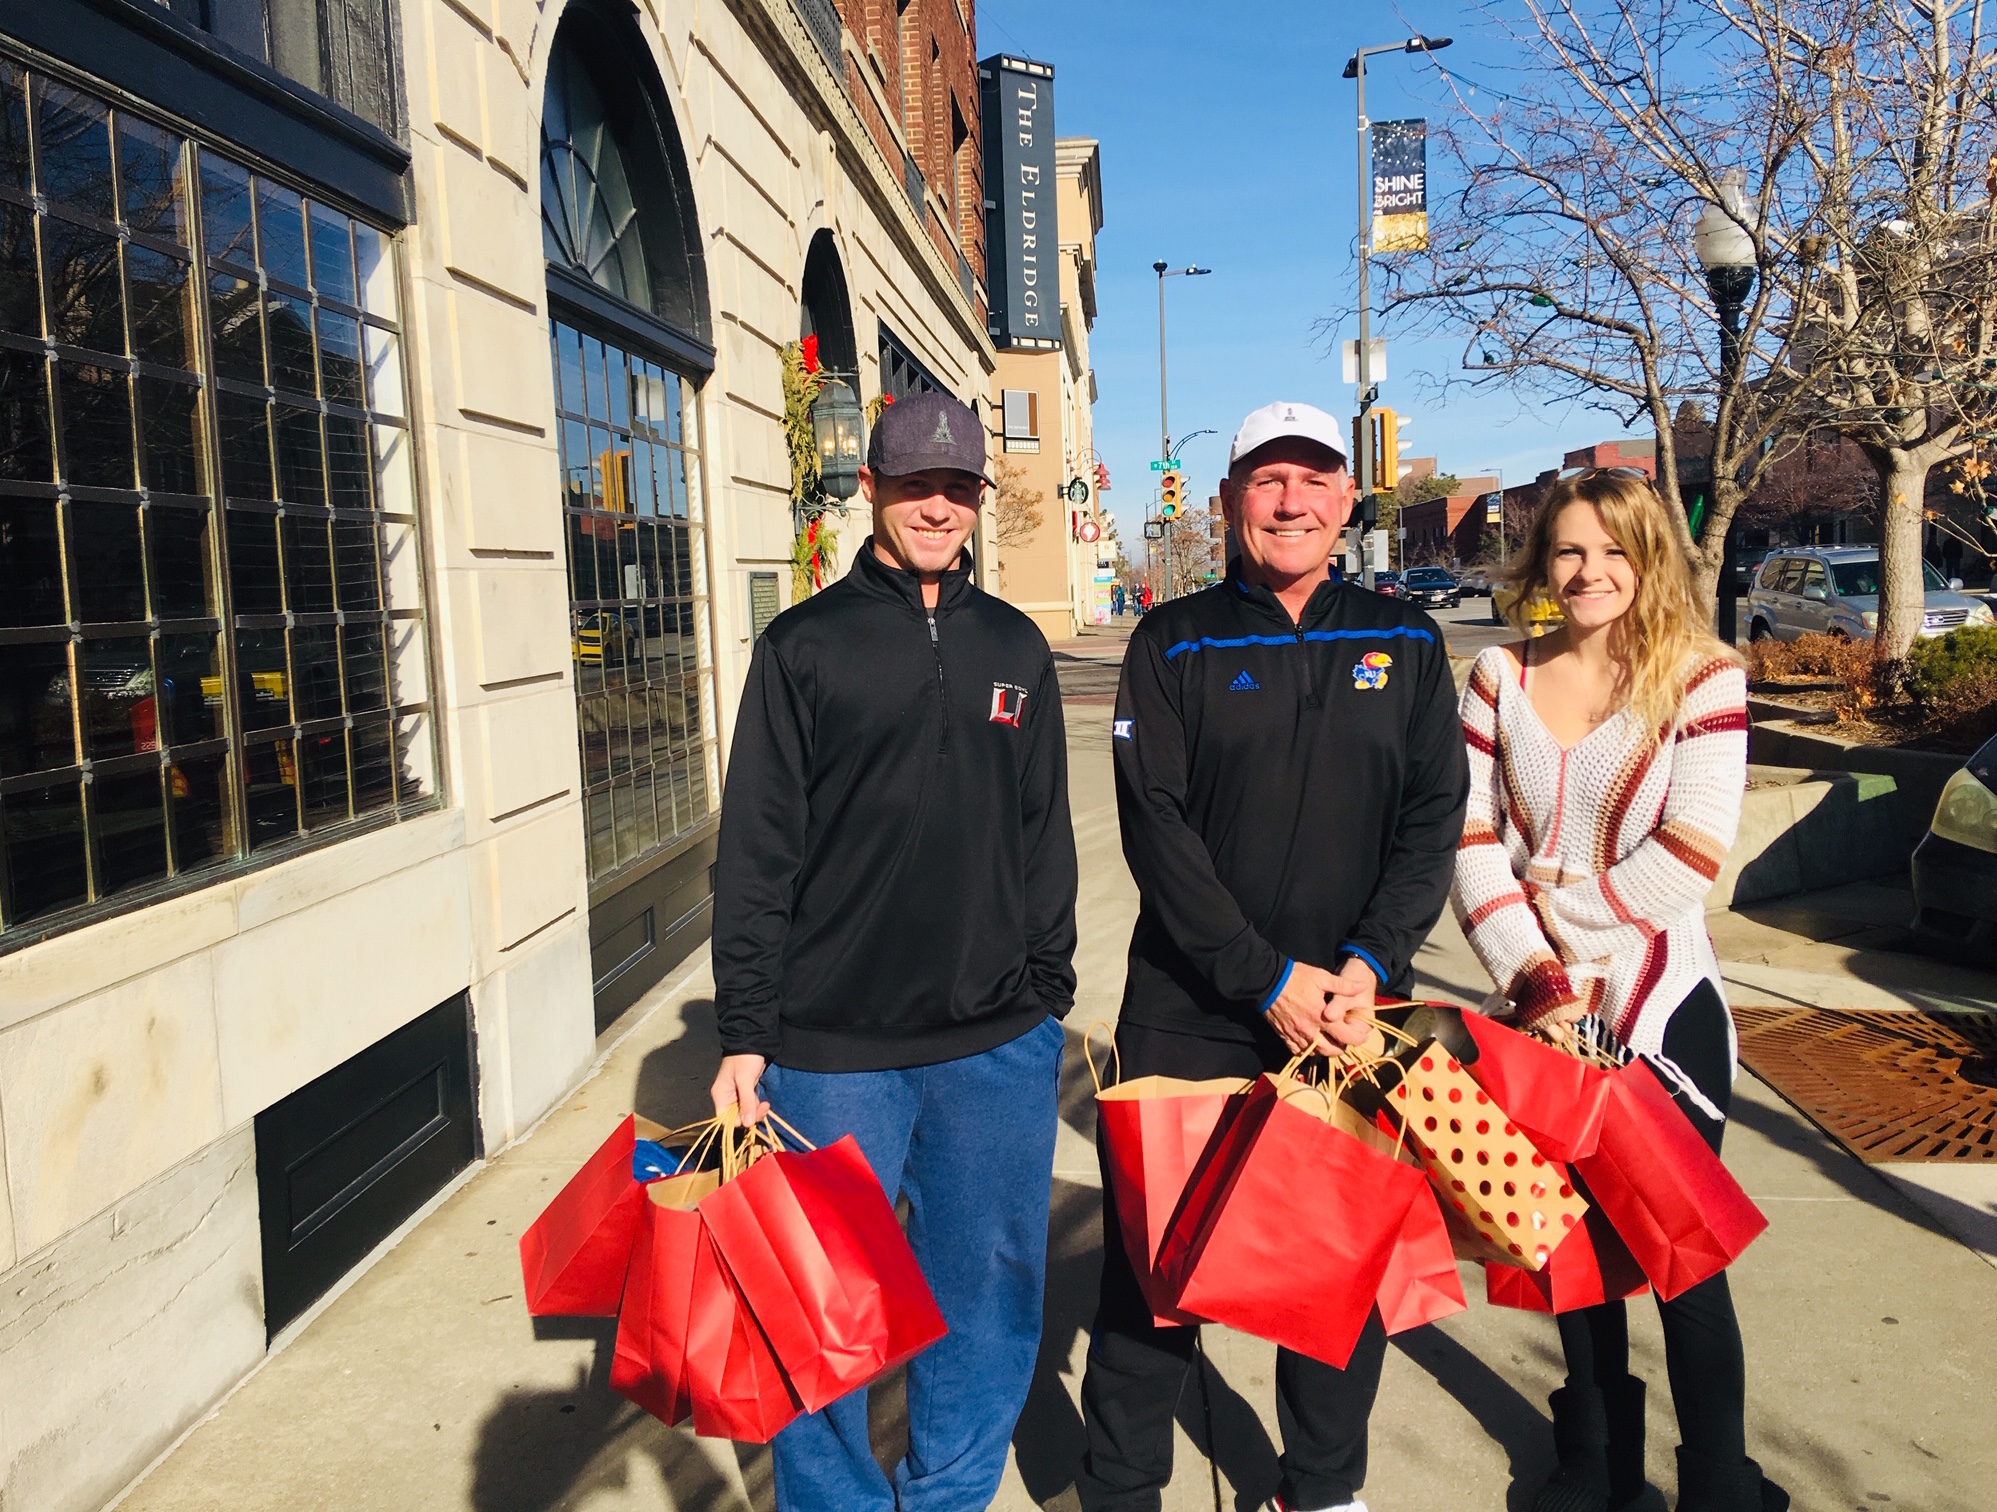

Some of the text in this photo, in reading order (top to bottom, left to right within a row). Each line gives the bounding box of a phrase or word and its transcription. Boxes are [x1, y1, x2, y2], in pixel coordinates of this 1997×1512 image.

[1374, 173, 1424, 193] SHINE
[1018, 83, 1041, 328] THE ELDRIDGE
[1373, 191, 1424, 208] BRIGHT
[1158, 461, 1170, 470] 7th
[1229, 682, 1260, 691] adidas
